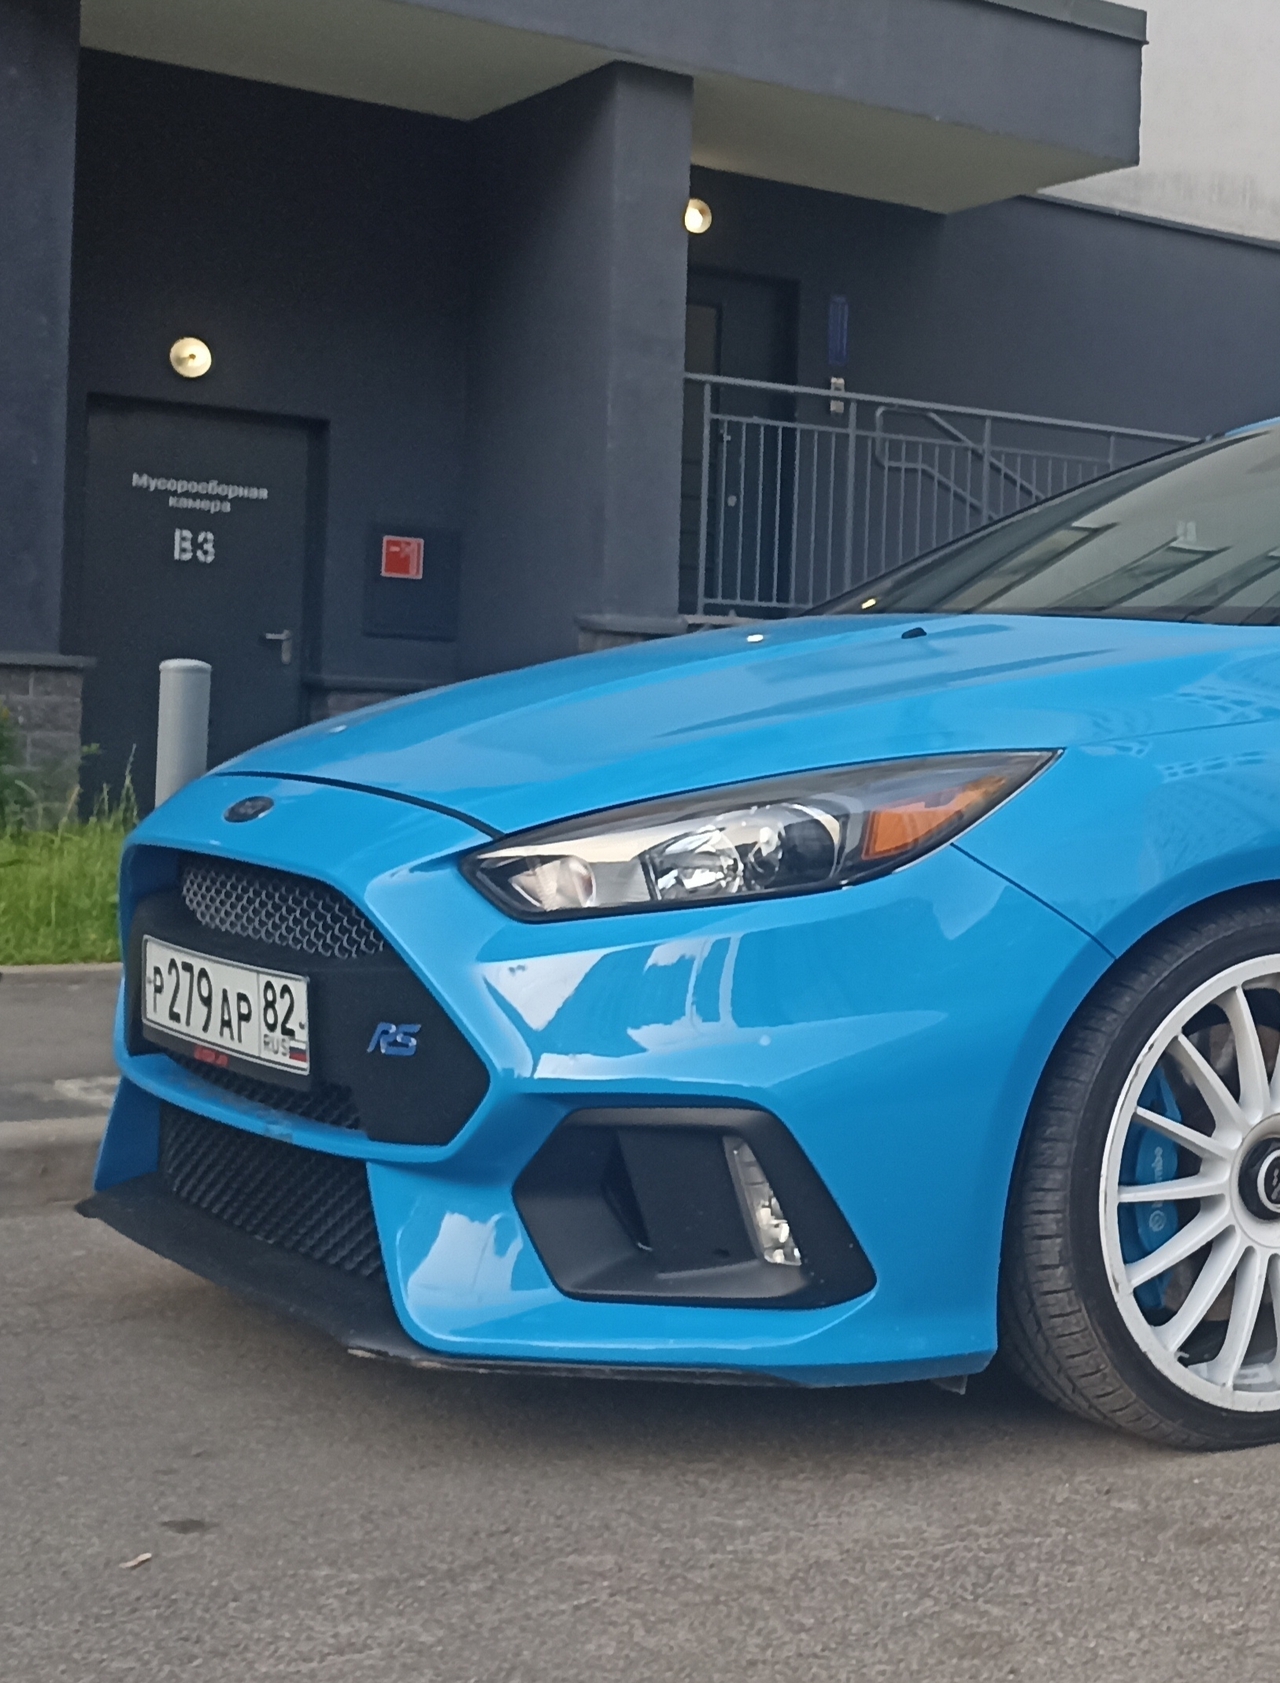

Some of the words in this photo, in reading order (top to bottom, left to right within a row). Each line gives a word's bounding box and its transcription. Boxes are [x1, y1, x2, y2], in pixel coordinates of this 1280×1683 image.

[132, 472, 268, 499] Мусоросборная
[168, 496, 231, 514] камера
[262, 980, 296, 1036] 82
[263, 1033, 291, 1057] RUS
[367, 1022, 422, 1056] RS
